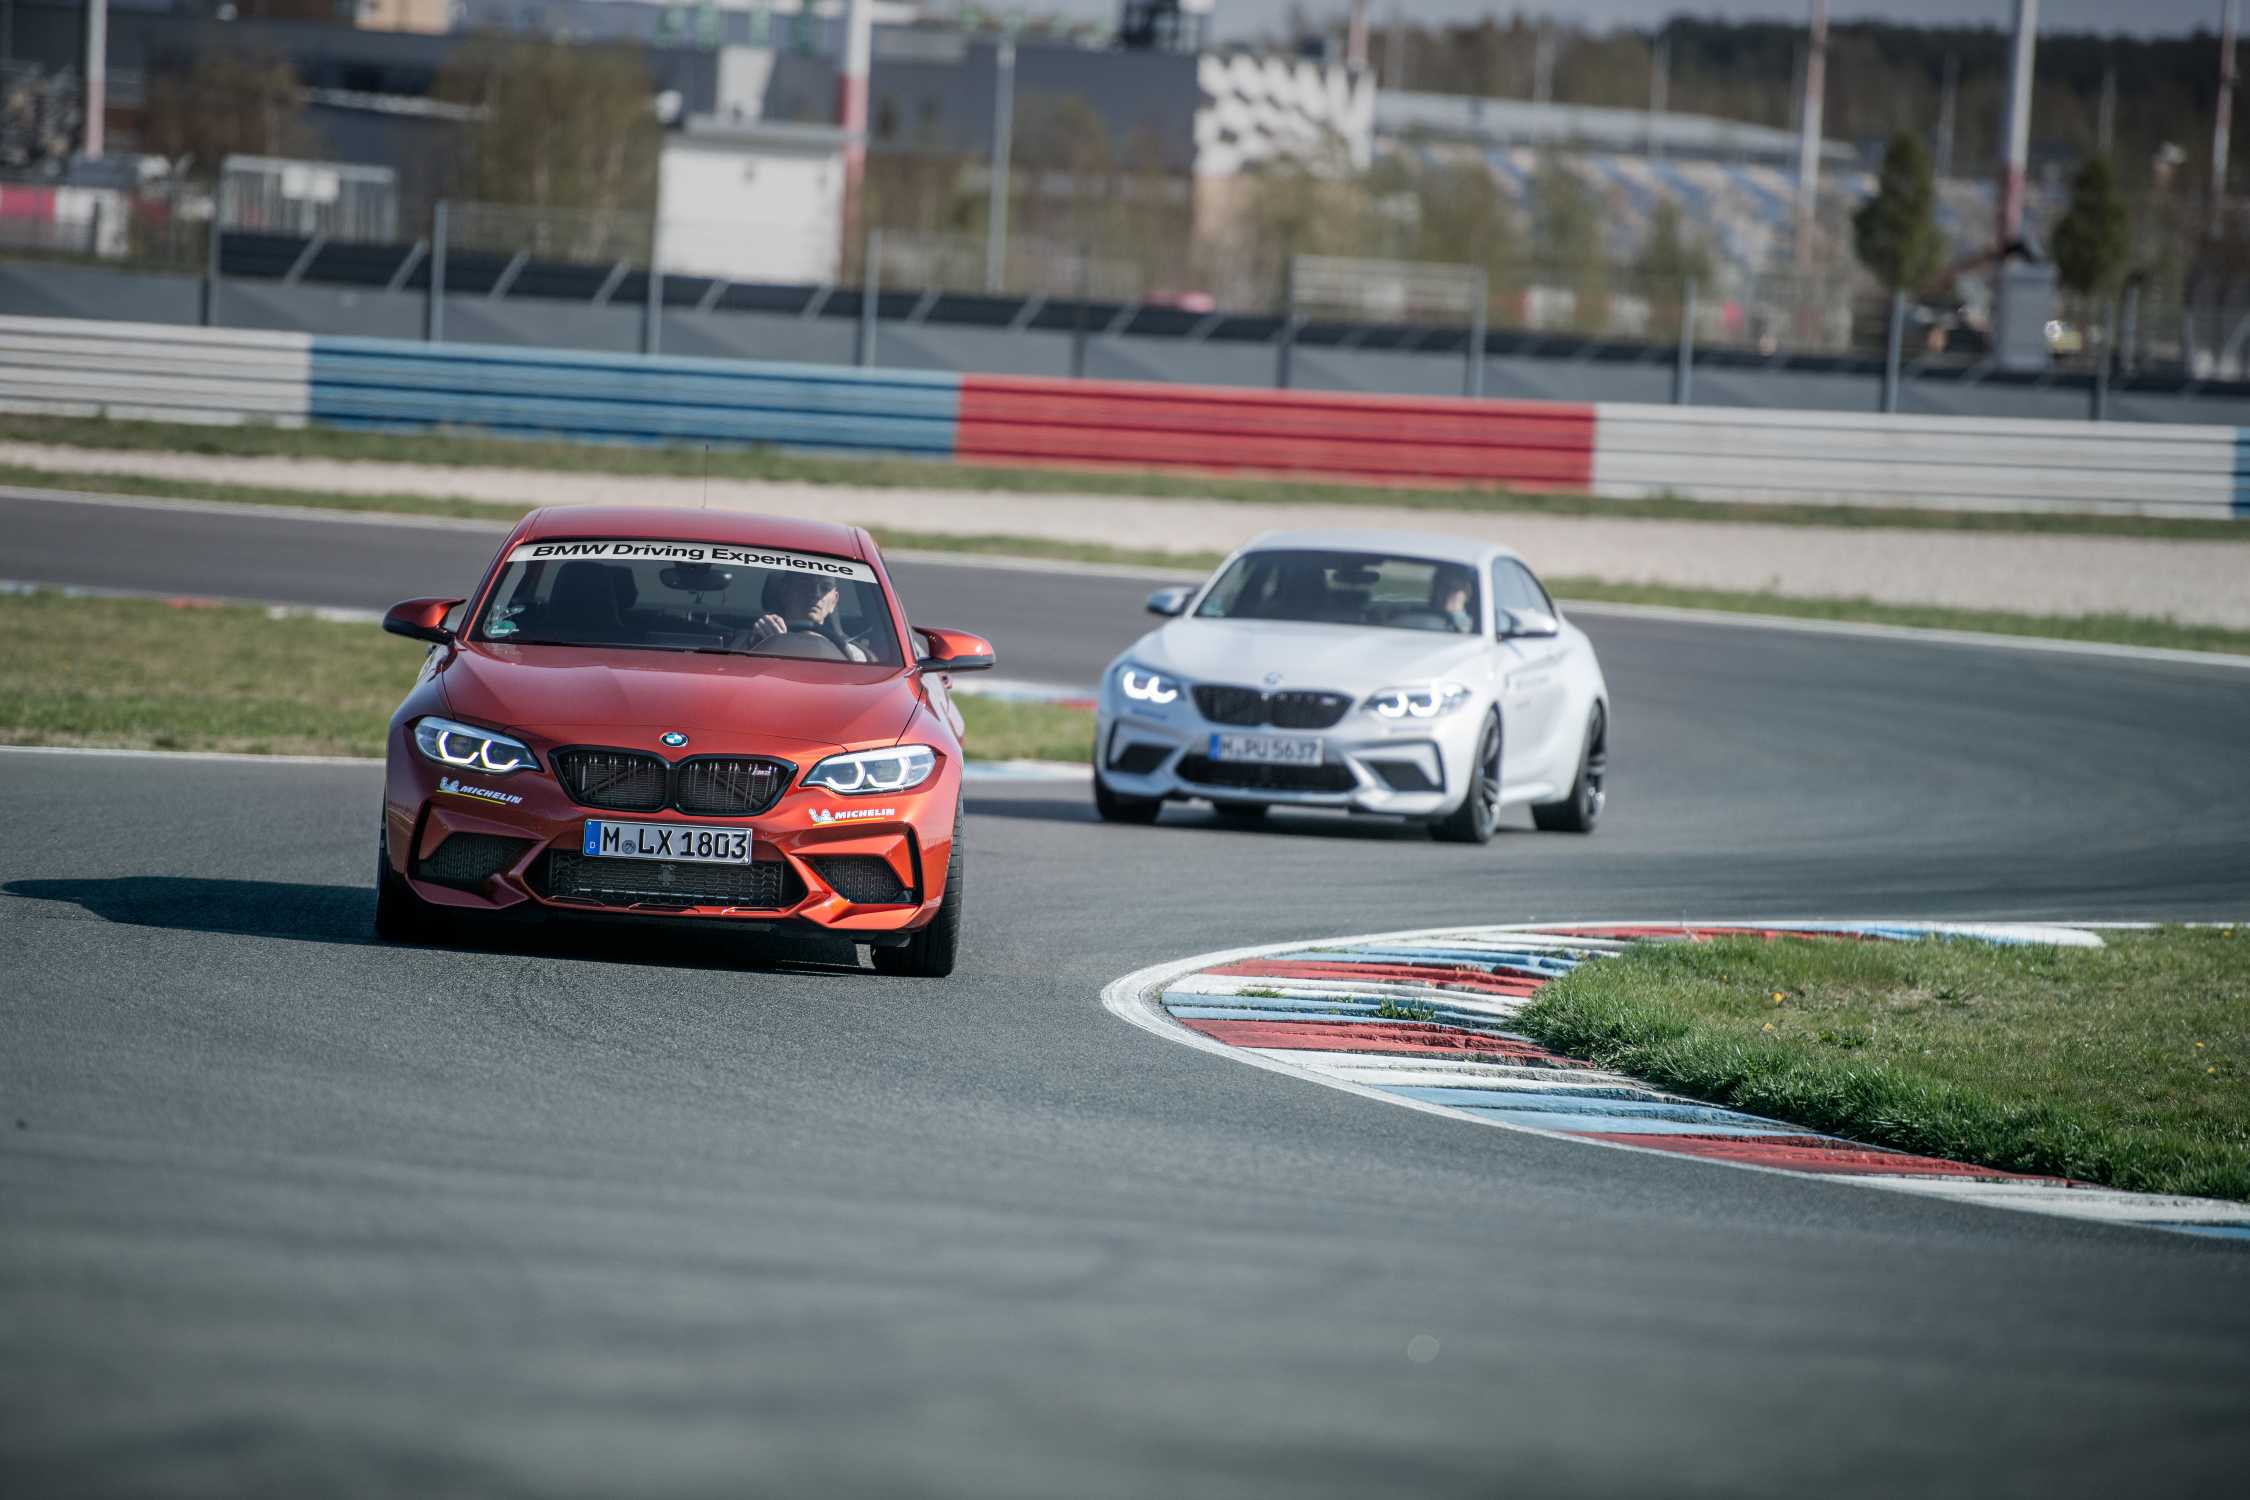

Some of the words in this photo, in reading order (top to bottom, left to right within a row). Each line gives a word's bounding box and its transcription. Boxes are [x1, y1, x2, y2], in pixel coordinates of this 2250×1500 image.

[532, 544, 609, 557] BMW
[612, 544, 704, 560] Driving
[711, 548, 854, 576] Experience
[459, 785, 524, 804] MICHELIN
[834, 808, 896, 820] MICHELIN
[602, 826, 620, 852] M
[638, 828, 673, 855] LX
[680, 831, 748, 859] 1803
